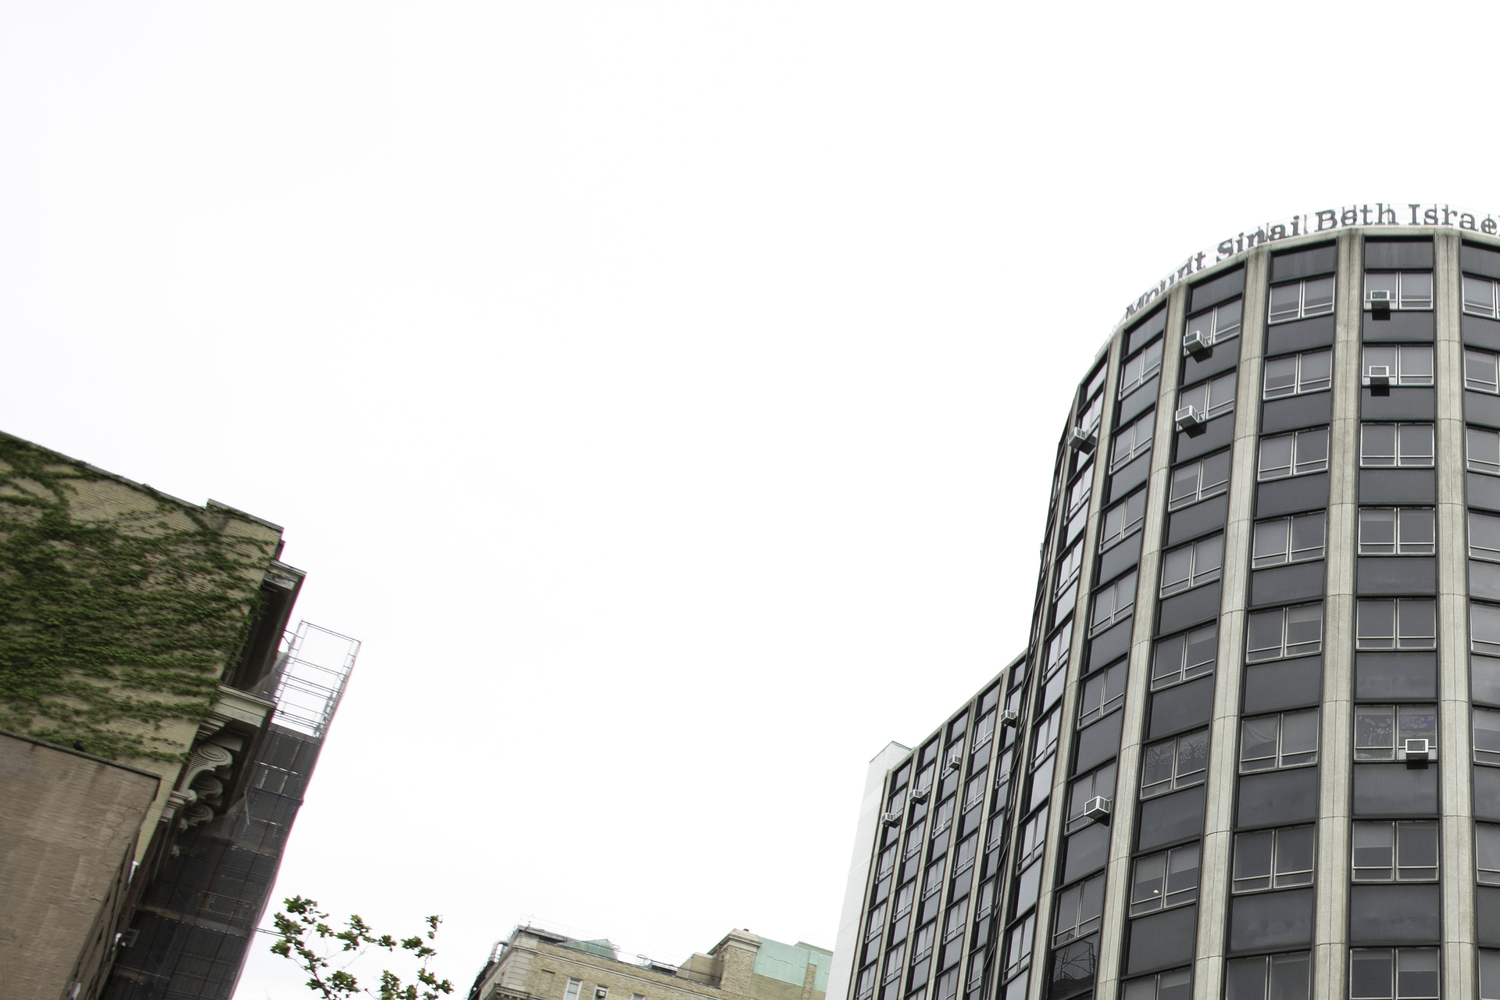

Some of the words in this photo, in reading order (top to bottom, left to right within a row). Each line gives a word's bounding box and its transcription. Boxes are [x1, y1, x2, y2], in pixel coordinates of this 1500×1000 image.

[1125, 251, 1206, 320] Mount
[1215, 215, 1301, 263] Sinai
[1314, 202, 1399, 233] Beth
